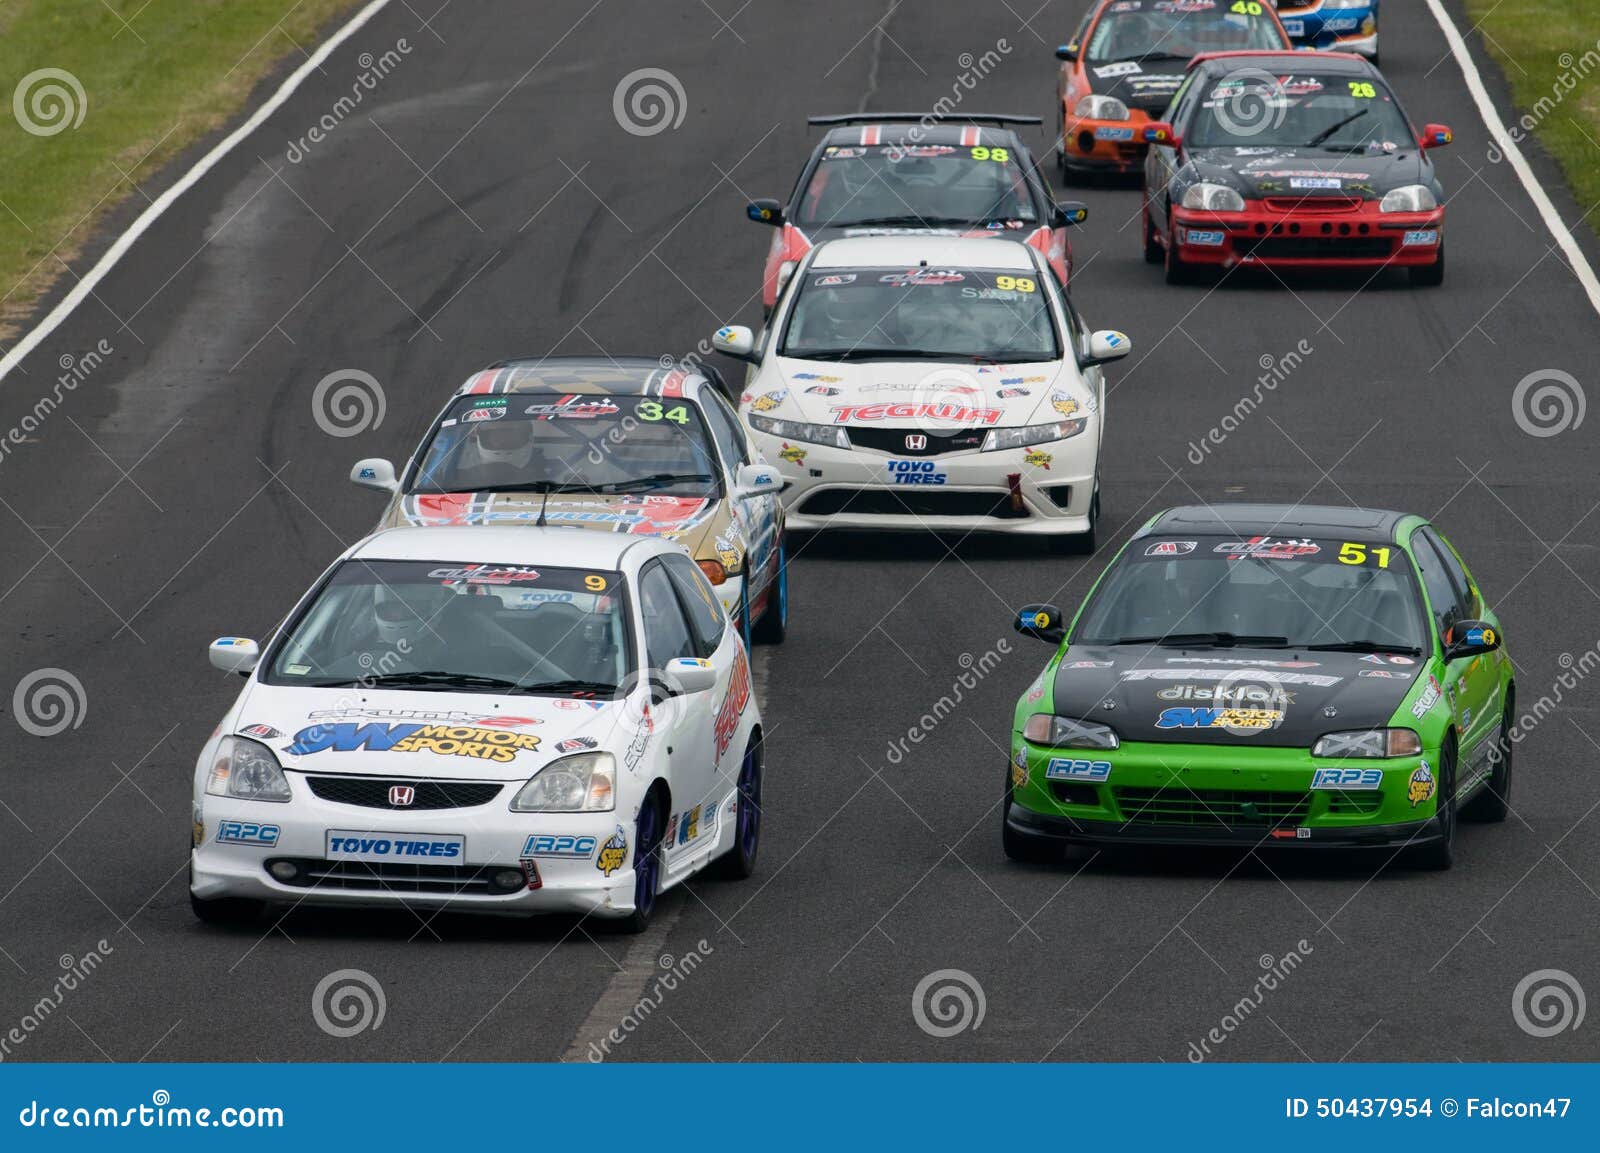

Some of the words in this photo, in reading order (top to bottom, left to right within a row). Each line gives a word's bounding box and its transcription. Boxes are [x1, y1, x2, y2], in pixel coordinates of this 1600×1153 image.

[1231, 1, 1262, 16] 40
[1348, 82, 1377, 98] 26
[971, 146, 1009, 162] 98
[996, 275, 1036, 293] 99
[639, 402, 690, 424] 34
[829, 401, 1005, 425] TEGIWA
[887, 460, 935, 472] TOYO
[895, 473, 947, 485] TIRES
[1338, 542, 1390, 568] 51
[584, 575, 606, 591] 9
[1155, 706, 1221, 728] SW
[1219, 709, 1284, 721] MOTOR
[1211, 718, 1273, 729] SPORTS
[281, 722, 428, 756] SW
[409, 723, 542, 752] MOTOR
[390, 737, 518, 762] SPORTS
[331, 837, 391, 855] TOYO
[394, 840, 461, 858] TIRES
